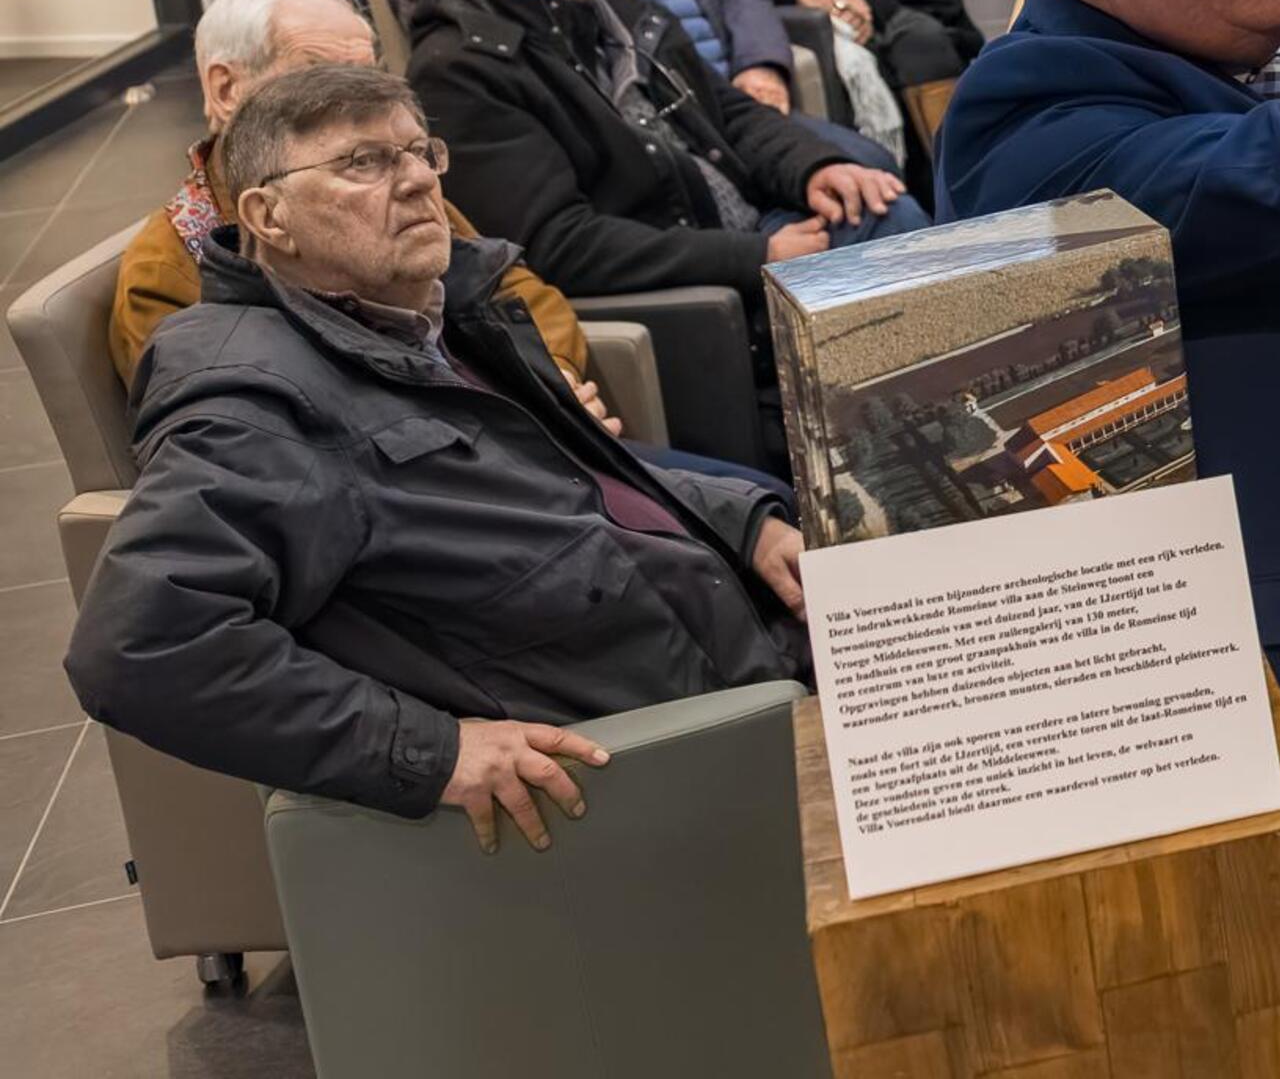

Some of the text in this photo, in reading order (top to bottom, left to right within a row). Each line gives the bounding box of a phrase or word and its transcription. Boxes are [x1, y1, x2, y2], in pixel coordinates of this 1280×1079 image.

[826, 543, 1225, 623] Villa Voerendaal is een bijzondere archeologische locatie met een rijk verleden.
[829, 570, 1155, 639] Deze indrukwekkende Romeinse villa aan de Steinweg toont een
[953, 622, 972, 632] van
[975, 616, 993, 627] wel
[995, 608, 1036, 624] duizend
[1038, 605, 1063, 619] jaar,
[1064, 601, 1083, 610] van
[1085, 597, 1098, 607] de
[1146, 585, 1160, 595] tot
[1163, 583, 1173, 592] in
[1175, 580, 1188, 589] de
[834, 658, 871, 671] Vroege
[955, 636, 976, 648] Met
[978, 634, 996, 644] een
[1065, 617, 1084, 626] van
[1087, 611, 1104, 623] 130
[835, 676, 853, 686] een
[856, 666, 899, 682] badhuis
[900, 665, 913, 674] en
[916, 660, 934, 670] een
[936, 653, 964, 669] groot
[1039, 636, 1060, 645] was
[1061, 632, 1074, 642] de
[1076, 627, 1099, 638] villa
[1100, 625, 1112, 635] in
[1113, 622, 1126, 632] de
[1128, 613, 1178, 629] Romeinse
[1179, 607, 1197, 620] tijd
[837, 690, 856, 700] een
[858, 681, 903, 696] centrum
[905, 677, 925, 686] van
[952, 669, 964, 678] en
[967, 658, 1015, 675] activiteit.
[839, 695, 909, 716] Opgravingen
[911, 687, 949, 702] hebben
[952, 676, 1005, 693] duizenden
[1007, 667, 1051, 682] objecten
[1054, 663, 1073, 673] aan
[1075, 658, 1091, 669] het
[1093, 653, 1117, 665] licht
[843, 712, 900, 729] waaronder
[903, 699, 963, 718] aardewerk,
[964, 691, 1007, 705] bronzen
[1009, 682, 1052, 696] munten,
[1054, 673, 1098, 688] sieraden
[1100, 670, 1112, 678] en
[1114, 655, 1173, 675] beschilderd
[848, 755, 879, 768] Naast
[881, 752, 894, 761] de
[896, 747, 919, 758] villa
[923, 742, 942, 754] zijn
[944, 737, 964, 748] ook
[966, 731, 1002, 746] sporen
[1004, 726, 1023, 736] van
[1025, 719, 1064, 732] eerdere
[1066, 715, 1079, 724] en
[1081, 709, 1110, 721] latere
[1112, 698, 1162, 714] bewoning
[879, 767, 898, 777] een
[900, 761, 920, 772] fort
[922, 757, 938, 768] uit
[940, 754, 953, 764] de
[1006, 741, 1024, 751] een
[1026, 730, 1079, 746] versterkte
[1080, 724, 1108, 736] toren
[1110, 719, 1125, 729] uit
[1126, 716, 1139, 726] de
[1215, 696, 1233, 709] tijd
[1235, 695, 1247, 704] en
[852, 786, 870, 796] een
[875, 770, 947, 791] begraafplaats
[950, 765, 964, 776] uit
[967, 763, 979, 772] de
[855, 799, 880, 810] Deze
[883, 788, 930, 803] vondsten
[933, 781, 963, 795] geven
[965, 777, 984, 787] een
[986, 769, 1015, 783] uniek
[1017, 761, 1052, 776] inzicht
[1054, 759, 1065, 769] in
[1068, 755, 1085, 766] het
[1119, 745, 1131, 755] de
[1135, 735, 1179, 751] welvaart
[1181, 734, 1193, 742] en
[856, 784, 1012, 823] de geschiedenis van de streek.
[859, 822, 884, 834] Villa
[886, 809, 946, 829] Voerendaal
[978, 795, 1023, 810] daarmee
[1025, 791, 1043, 800] een
[1046, 777, 1099, 796] waardevol
[1101, 770, 1138, 784] venster
[1141, 768, 1154, 776] op
[1155, 763, 1172, 773] het
[1174, 754, 1221, 769] verleden.
